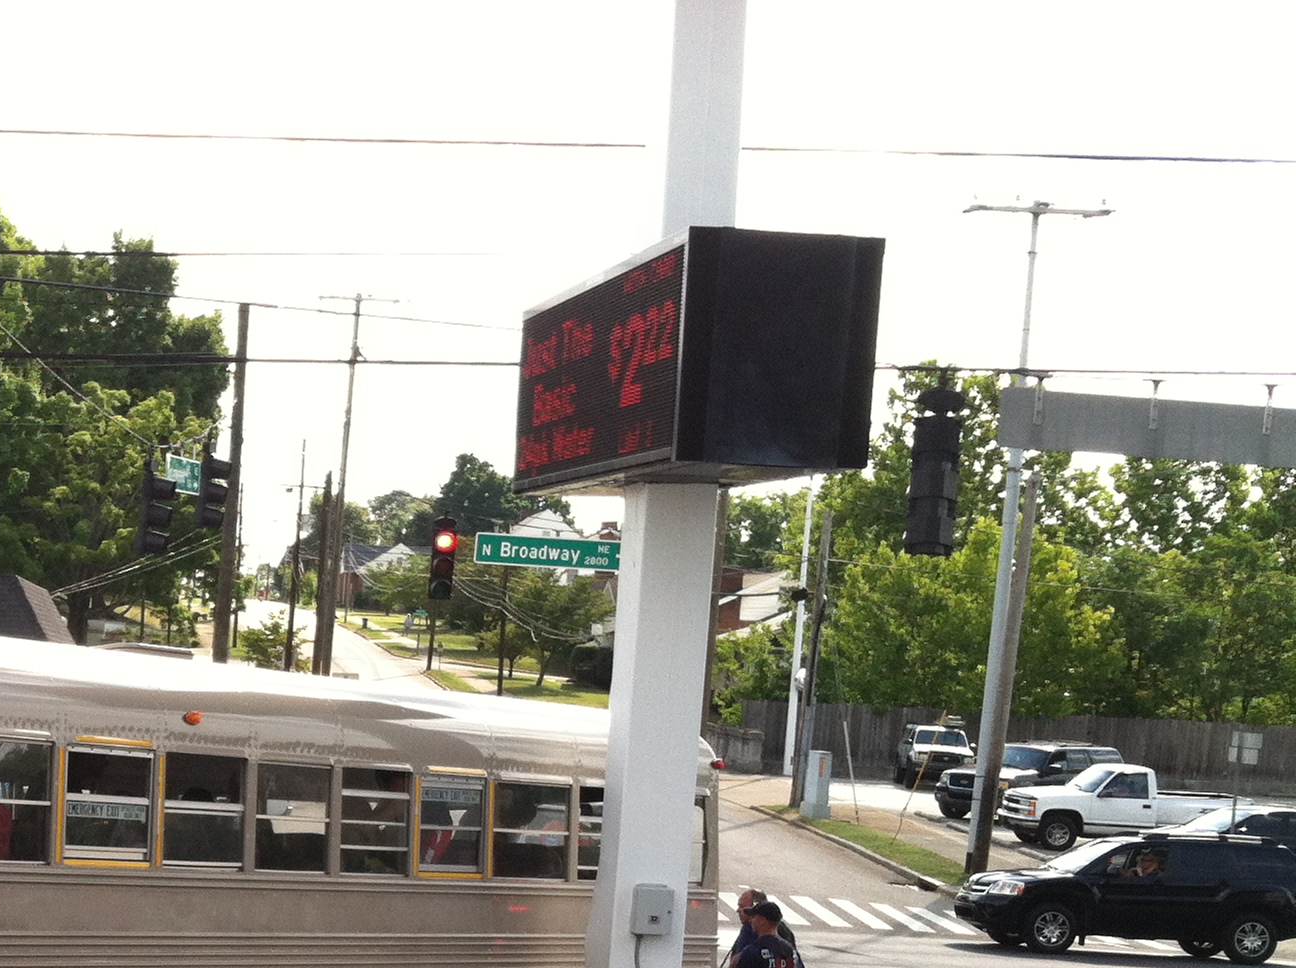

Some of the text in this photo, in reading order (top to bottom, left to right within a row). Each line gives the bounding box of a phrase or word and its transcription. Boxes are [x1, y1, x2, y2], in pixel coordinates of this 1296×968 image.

[482, 542, 580, 565] N Broadway
[598, 545, 610, 554] NE
[584, 556, 609, 566] 2800
[68, 803, 104, 816] EMERGENCY
[106, 805, 120, 817] EXIT
